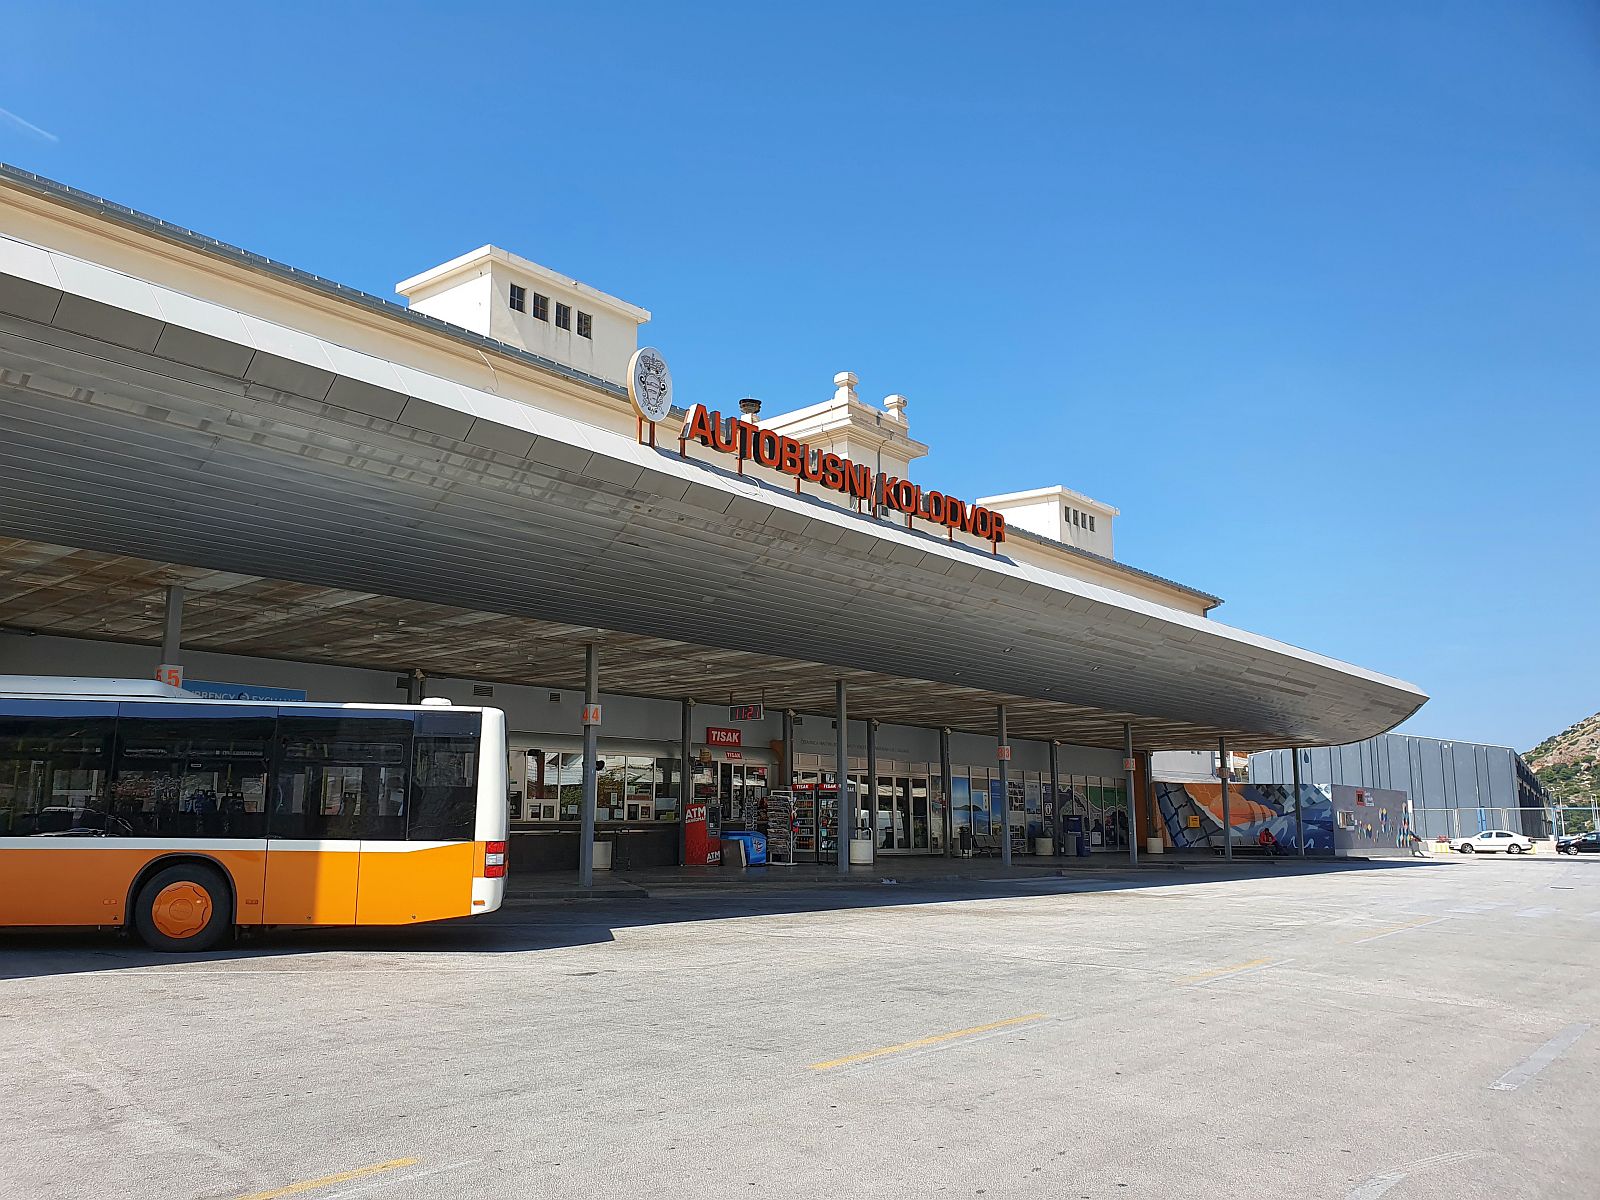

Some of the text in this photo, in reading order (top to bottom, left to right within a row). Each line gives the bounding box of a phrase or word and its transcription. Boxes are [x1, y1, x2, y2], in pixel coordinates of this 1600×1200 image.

[686, 403, 1006, 543] AUTOBUSNI KOLODVOR
[167, 669, 180, 688] 5
[583, 707, 588, 721] 4
[592, 707, 599, 721] 4
[711, 730, 740, 743] TISAK
[685, 806, 706, 820] ATM
[707, 850, 721, 863] ATM
